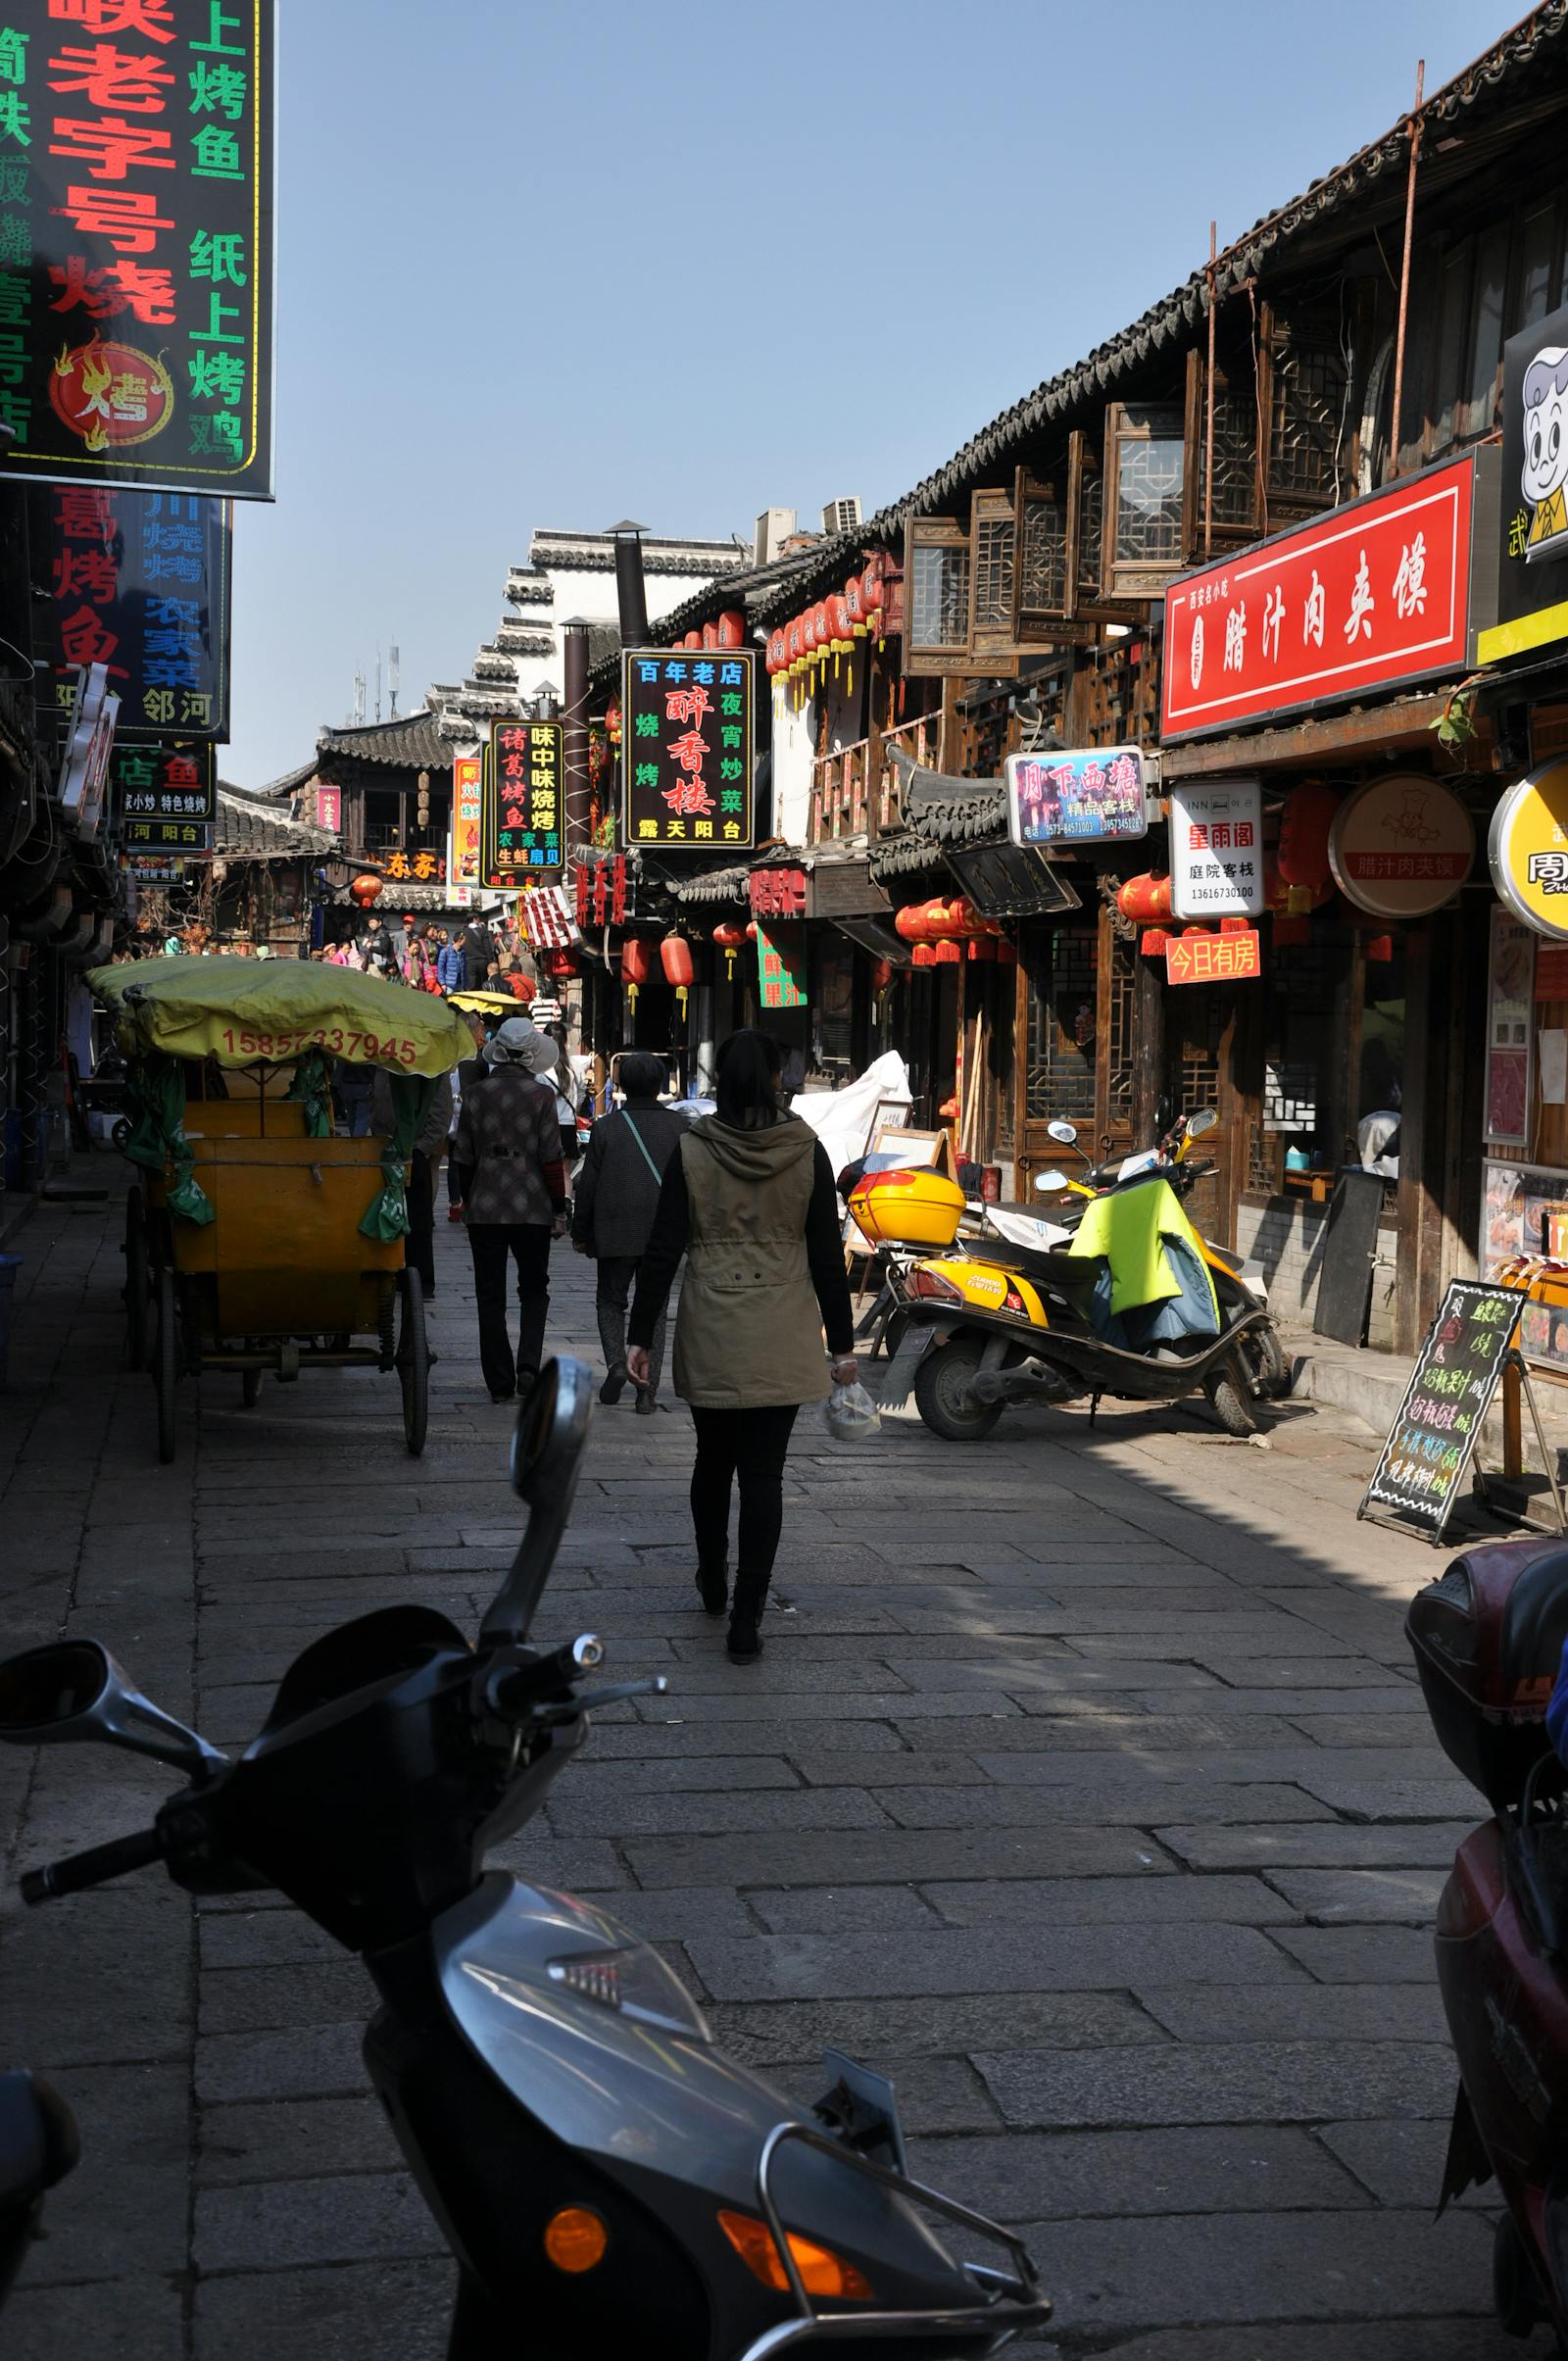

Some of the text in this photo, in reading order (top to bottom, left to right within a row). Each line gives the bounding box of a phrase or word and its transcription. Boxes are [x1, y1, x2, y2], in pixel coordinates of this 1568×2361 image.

[1189, 579, 1229, 610] 西安名小吃
[637, 661, 743, 685] 百年老店
[635, 713, 660, 788] 烧烤
[662, 686, 715, 816] 醉香楼
[720, 692, 743, 813] 夜宵炒菜
[499, 727, 528, 830] 诸葛烤鱼
[530, 727, 556, 831] 味中味烧烤
[1024, 756, 1137, 801] 月下西塘
[161, 795, 206, 813] 特色烧烤
[1066, 798, 1136, 818] 精品客栈
[1188, 800, 1208, 811] INN
[162, 825, 197, 841] 阳台
[498, 832, 559, 848] 农家菜
[638, 819, 741, 839] 露天阳台
[1189, 821, 1254, 850] 星雨阁
[1189, 861, 1254, 879] 庭院客栈
[1357, 857, 1455, 876] 腊汁肉夹馍
[1192, 886, 1253, 900] 13616730100
[1170, 936, 1255, 977] 今日有房
